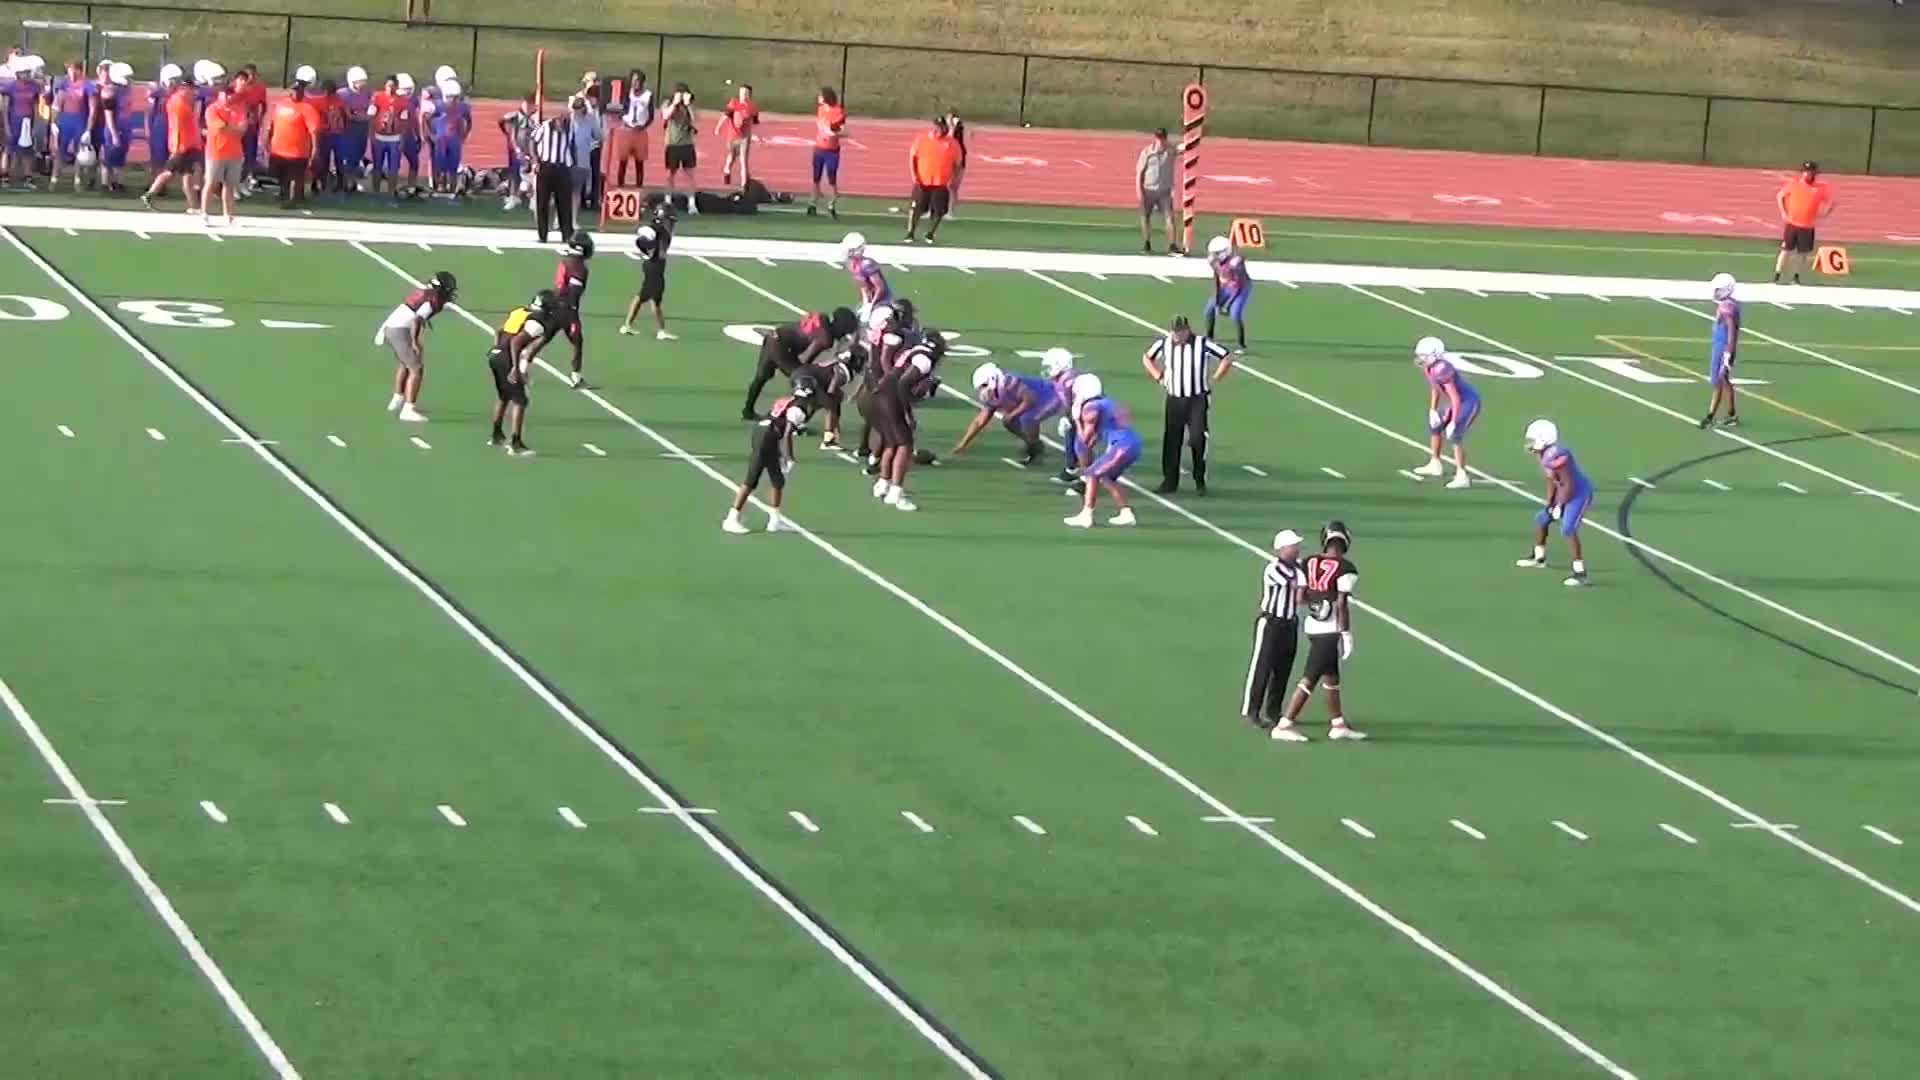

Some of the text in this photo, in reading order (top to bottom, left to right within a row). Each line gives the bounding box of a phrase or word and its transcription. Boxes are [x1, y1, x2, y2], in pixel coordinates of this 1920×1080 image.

[611, 193, 637, 218] 20
[1238, 223, 1262, 245] 10
[1829, 250, 1844, 271] G
[1307, 557, 1339, 592] 17
